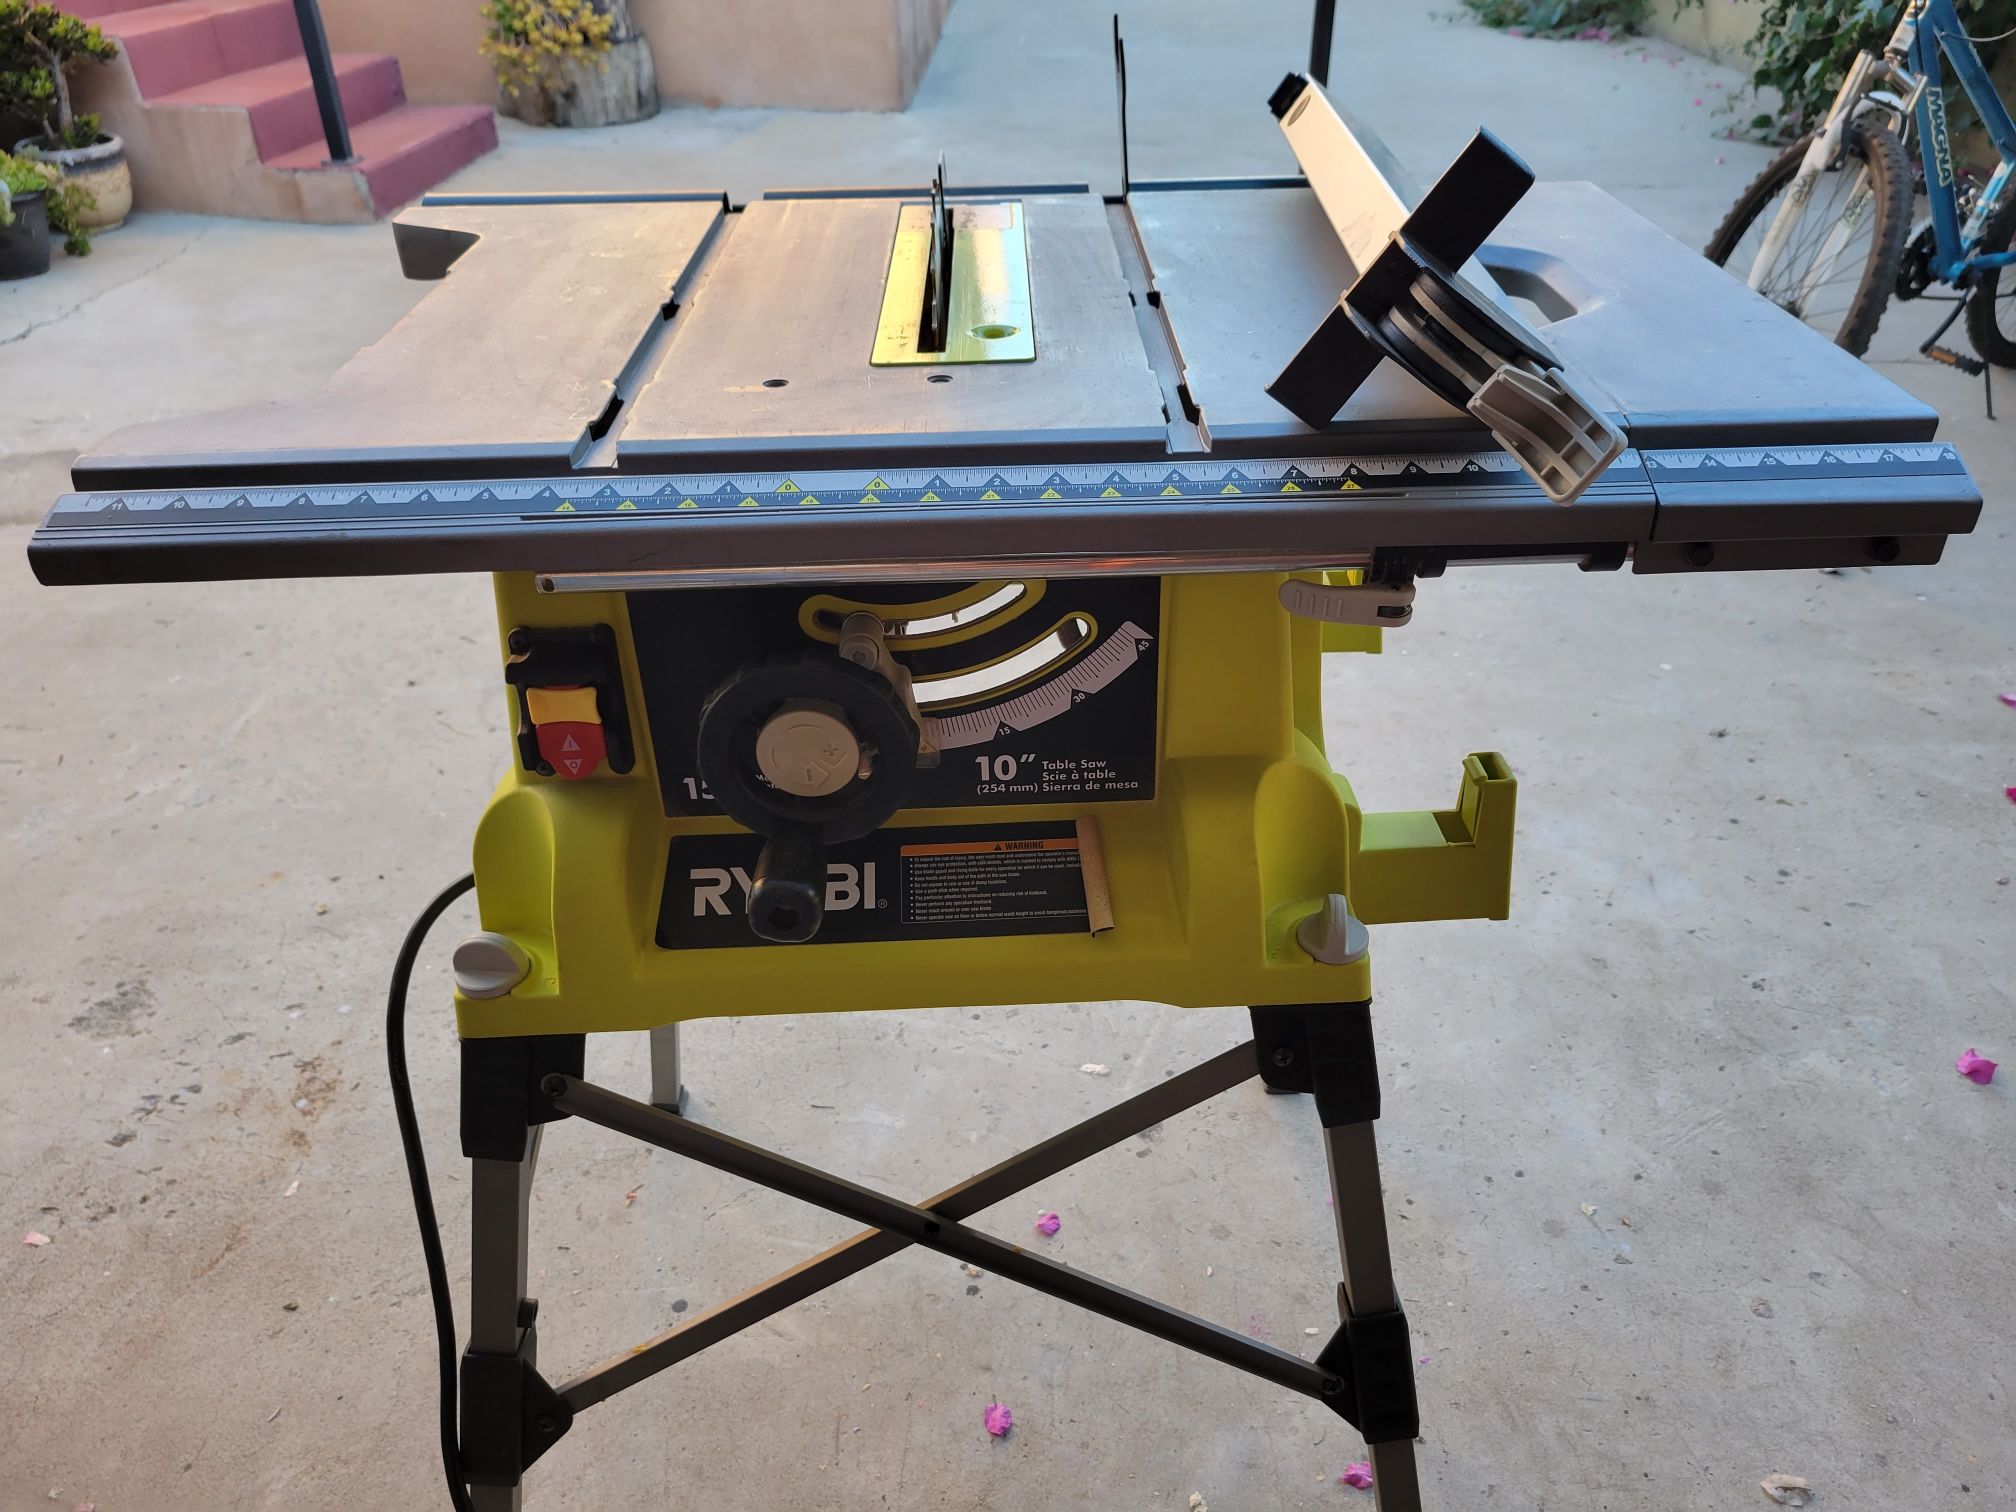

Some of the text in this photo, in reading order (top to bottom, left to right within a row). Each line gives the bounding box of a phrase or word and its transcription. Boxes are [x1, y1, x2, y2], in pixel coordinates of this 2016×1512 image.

[1926, 87, 1952, 187] MAGNA
[1646, 452, 1956, 469] 13 14 15 16 17 18
[110, 502, 122, 511] 11
[172, 500, 185, 509] 10
[236, 499, 244, 507] 9
[298, 497, 306, 505] 8
[359, 495, 368, 503] 7
[420, 493, 429, 502] 6
[481, 491, 490, 500] 5
[542, 489, 551, 498] 4
[603, 488, 611, 496] 3
[663, 487, 672, 495] 2
[724, 485, 731, 493] 1
[874, 481, 881, 489] 0
[934, 479, 941, 487] 1
[1053, 476, 1060, 484] 3
[1112, 475, 1120, 483] 4
[1172, 473, 1180, 481] 5
[1231, 471, 1239, 479] 6
[1290, 469, 1298, 477] 7
[1350, 468, 1358, 476] 8
[1409, 465, 1417, 474] 9
[1466, 464, 1479, 472] 10
[1137, 640, 1150, 653] 45
[1073, 692, 1087, 704] 30
[998, 726, 1011, 737] 15
[1042, 759, 1107, 770] Table Saw
[1042, 769, 1116, 781] Scie à table
[977, 780, 1139, 794] (254 mm) Sierra de mesa
[1004, 841, 1044, 850] WARNING
[690, 862, 876, 917] RYBI
